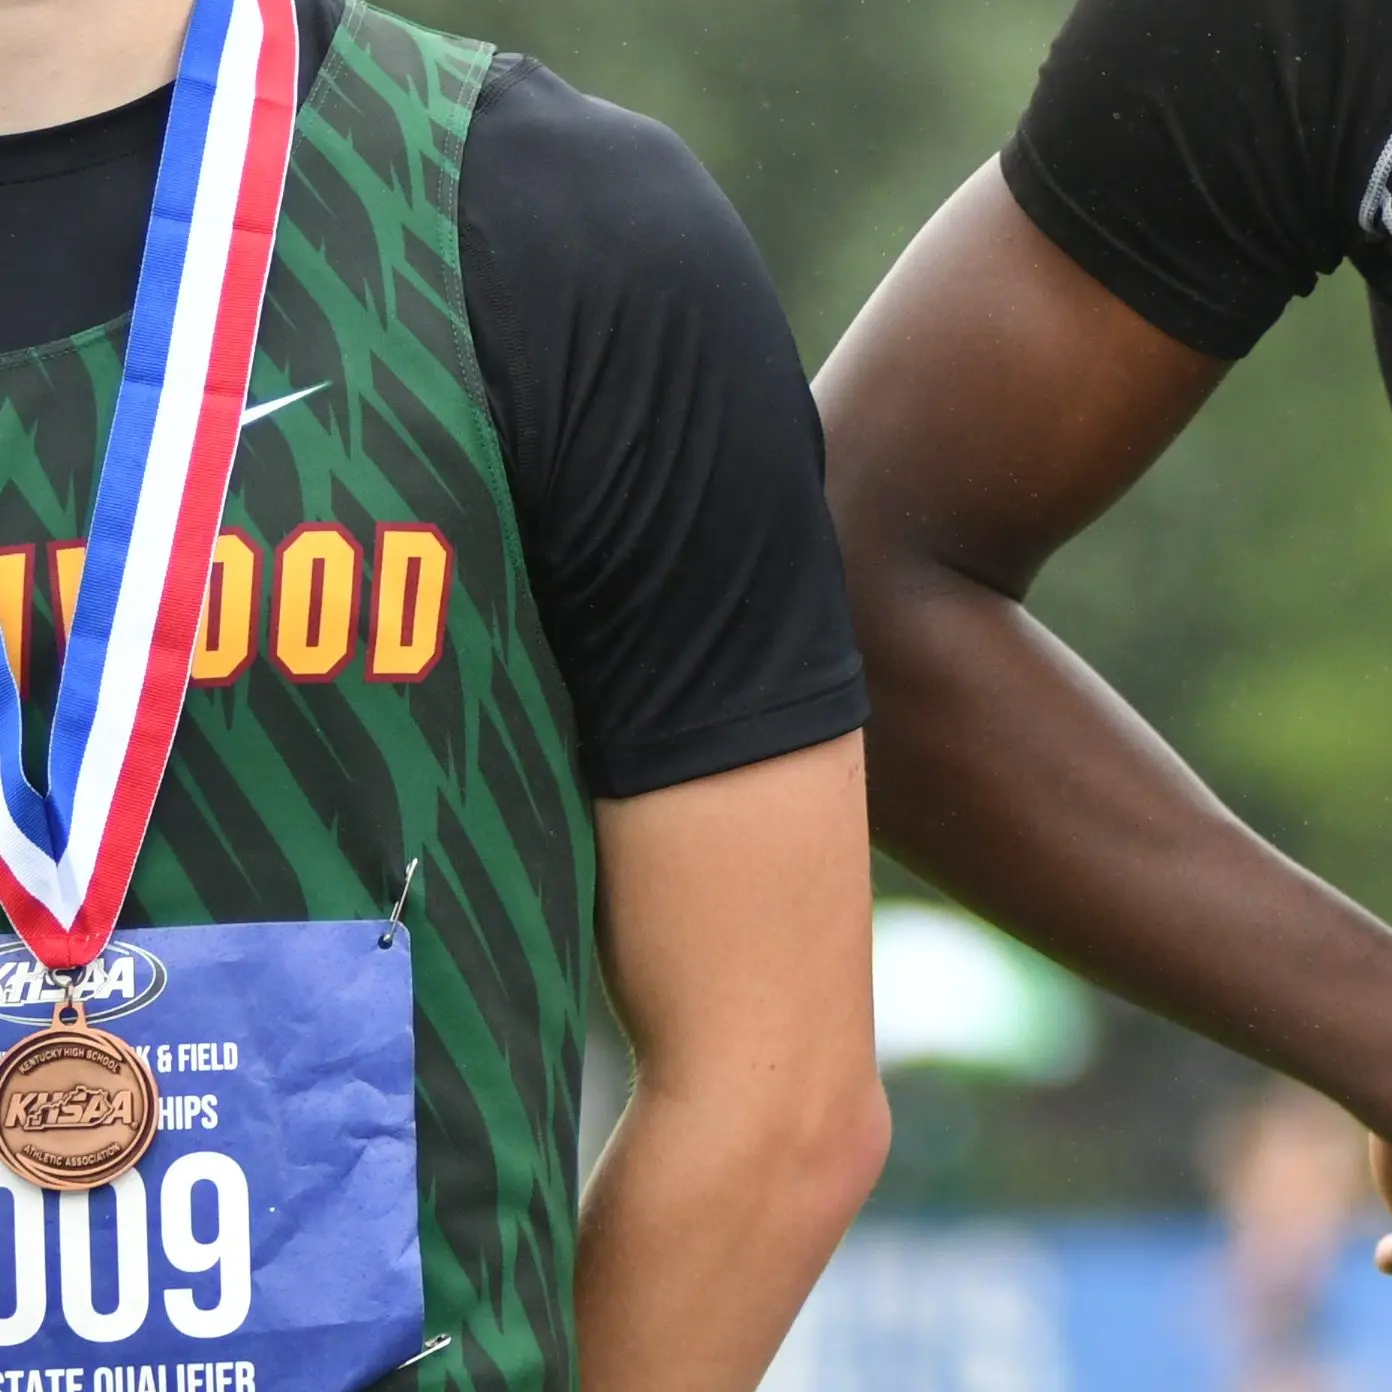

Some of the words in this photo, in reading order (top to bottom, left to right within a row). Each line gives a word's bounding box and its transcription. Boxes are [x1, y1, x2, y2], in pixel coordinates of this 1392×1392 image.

[18, 1047, 62, 1075] KENTUCKY
[64, 1047, 85, 1059] HIGH
[86, 1050, 121, 1075] SCHOOL
[156, 1046, 171, 1073] &
[178, 1042, 239, 1072] FIELD
[5, 1088, 134, 1130] KHSAA
[23, 1144, 62, 1166] ATHLETIC
[65, 1143, 121, 1167] ASSOCIATION
[0, 1368, 84, 1392] TATE
[93, 1360, 256, 1392] QUALIFIER
